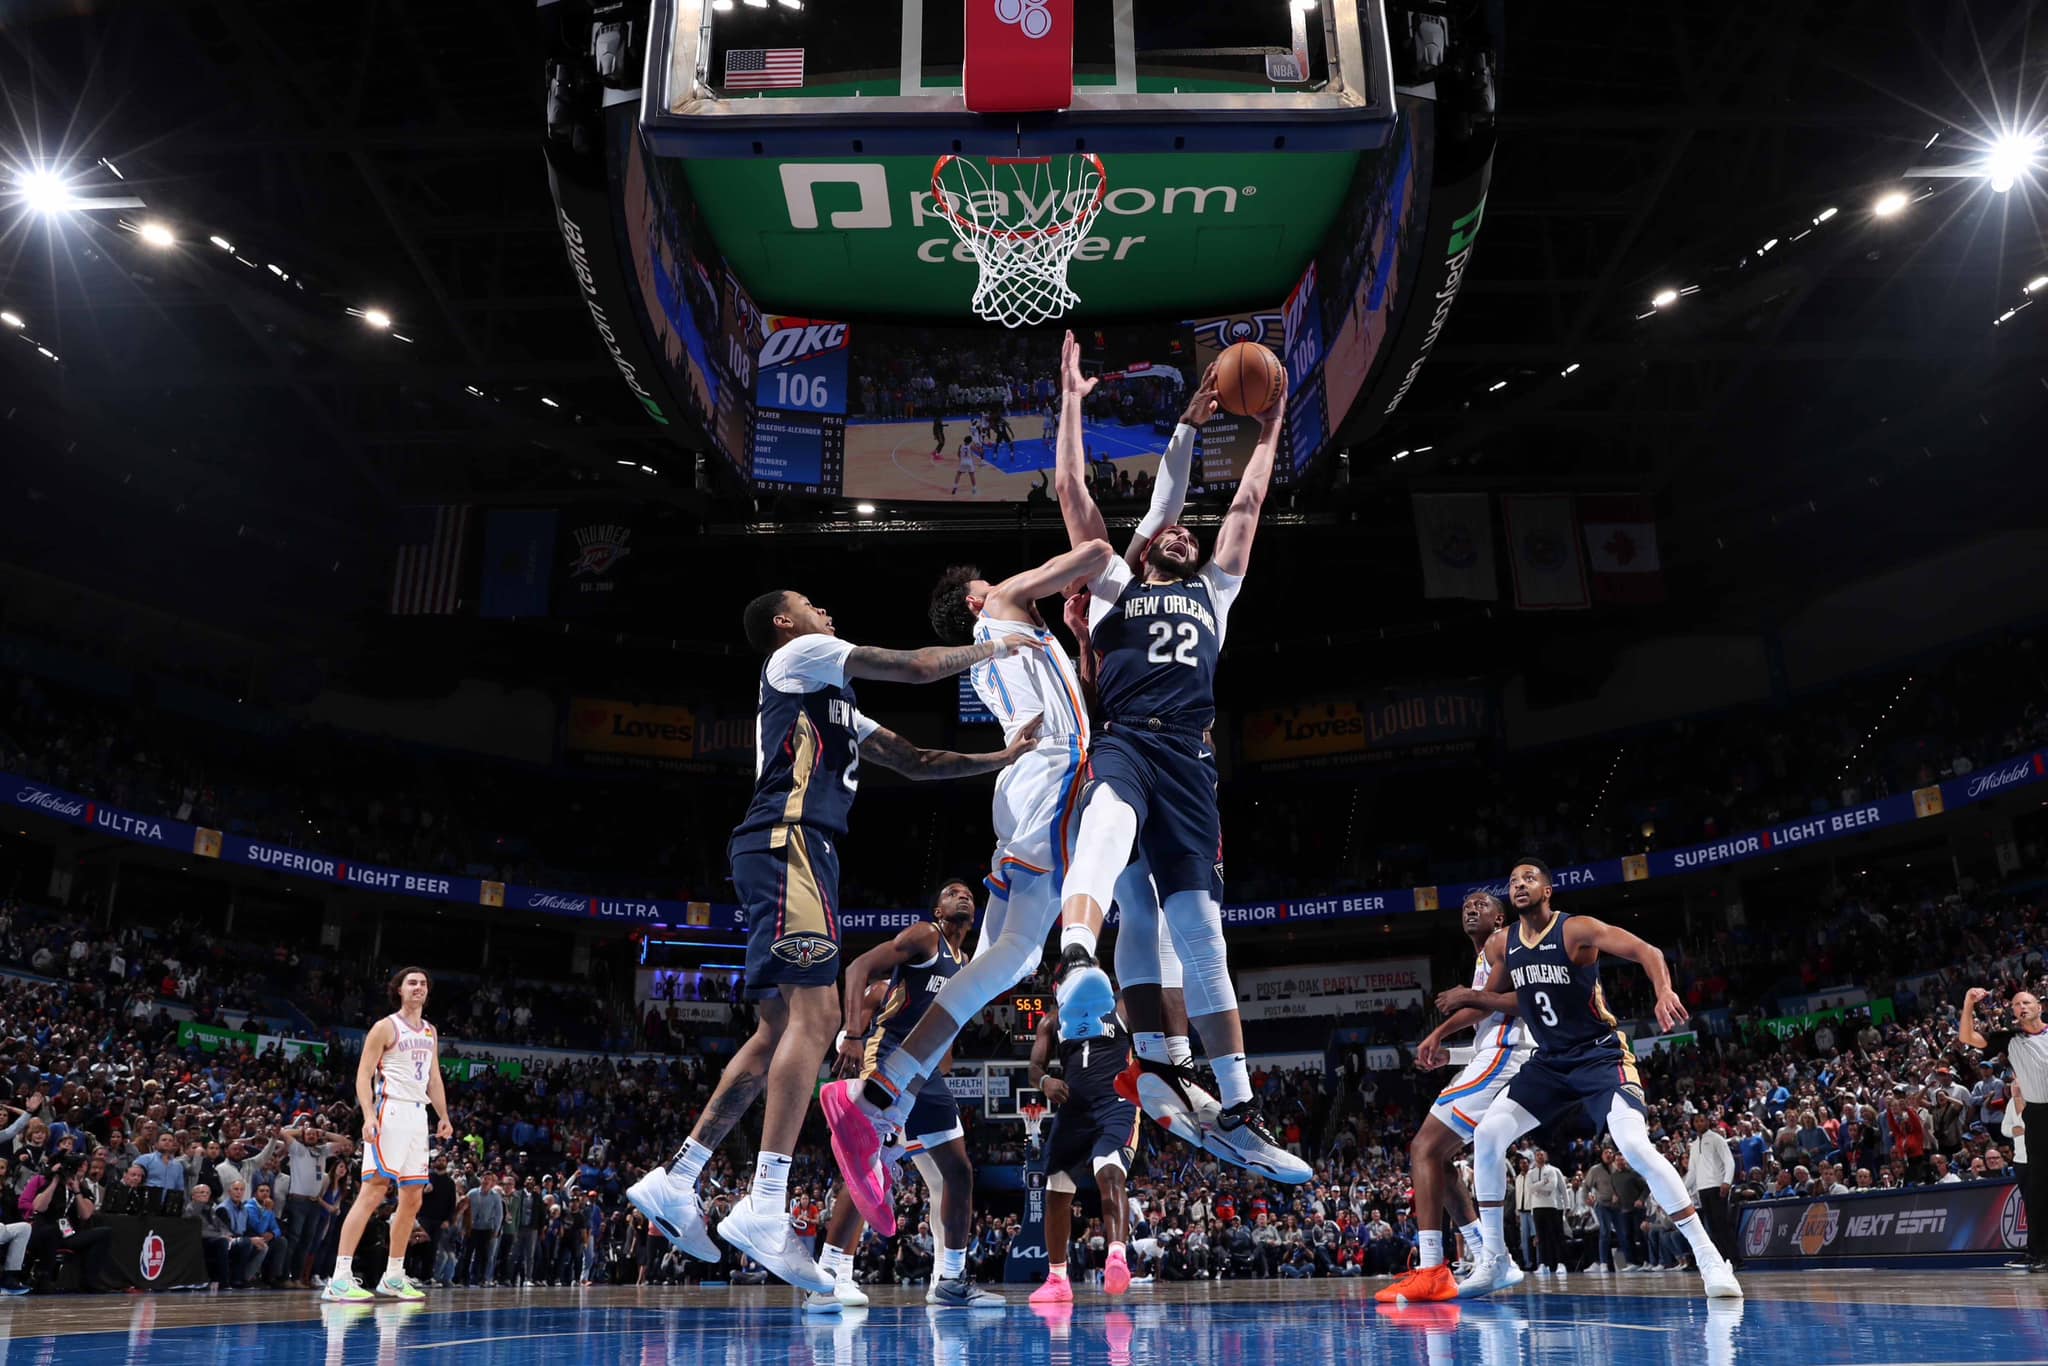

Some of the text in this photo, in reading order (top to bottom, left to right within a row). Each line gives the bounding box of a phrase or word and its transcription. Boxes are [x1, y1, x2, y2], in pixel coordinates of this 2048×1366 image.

[758, 323, 848, 369] OKC
[1293, 328, 1316, 384] 106
[728, 334, 750, 389] 108
[776, 372, 828, 408] 106
[1125, 595, 1216, 636] NEW ORLEANS
[1148, 620, 1199, 667] 22
[828, 698, 850, 728] NEW
[1967, 761, 2030, 798] Michelob
[17, 786, 164, 840] Michelob ULTRA
[1673, 807, 1880, 868] SUPERIOR LIGHT BEER
[247, 844, 450, 895] SUPERIOR LIGHT BEER
[528, 892, 660, 919] Michelob ULTRA
[838, 914, 876, 927] IGHT
[1220, 896, 1385, 922] PERIOR LIGHT BEER
[1257, 971, 1417, 995] POST OAK PARTY TERRACE
[1510, 966, 1526, 990] EW
[1526, 964, 1571, 985] ORLEANS
[1016, 998, 1042, 1011] 56.9
[1535, 991, 1559, 1027] 3
[1082, 1040, 1090, 1068] 1
[1370, 1054, 1393, 1069] 112
[415, 1062, 423, 1081] 3
[949, 1079, 983, 1089] HEALTH
[1844, 1213, 1895, 1238] NEXT
[1895, 1209, 1947, 1236] ESPN
